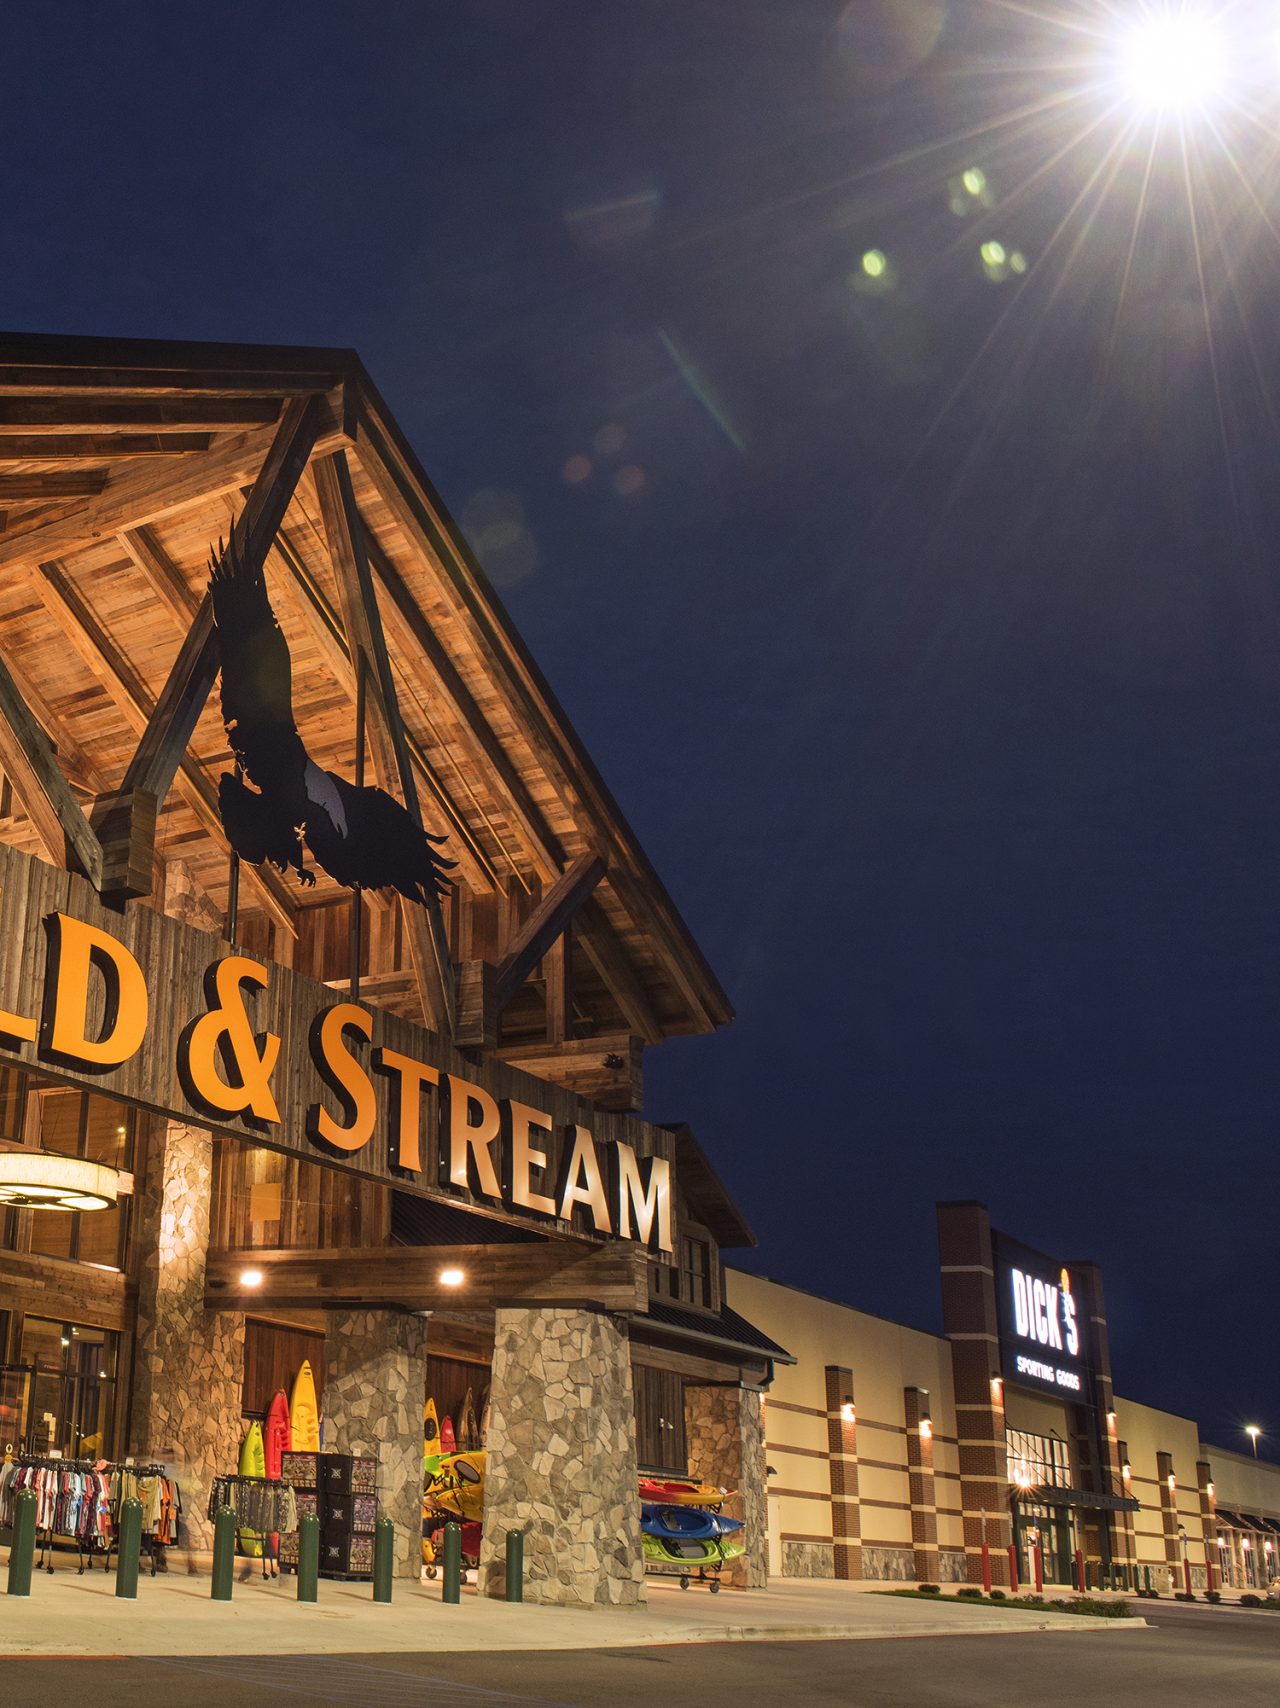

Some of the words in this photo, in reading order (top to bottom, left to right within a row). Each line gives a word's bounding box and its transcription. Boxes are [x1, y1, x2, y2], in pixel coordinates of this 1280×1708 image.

[187, 955, 282, 1125] &
[317, 1002, 674, 1254] STREAM
[1011, 1268, 1079, 1356] DICK'S
[1017, 1355, 1055, 1383] SPORTING
[1056, 1368, 1080, 1391] GOODS
